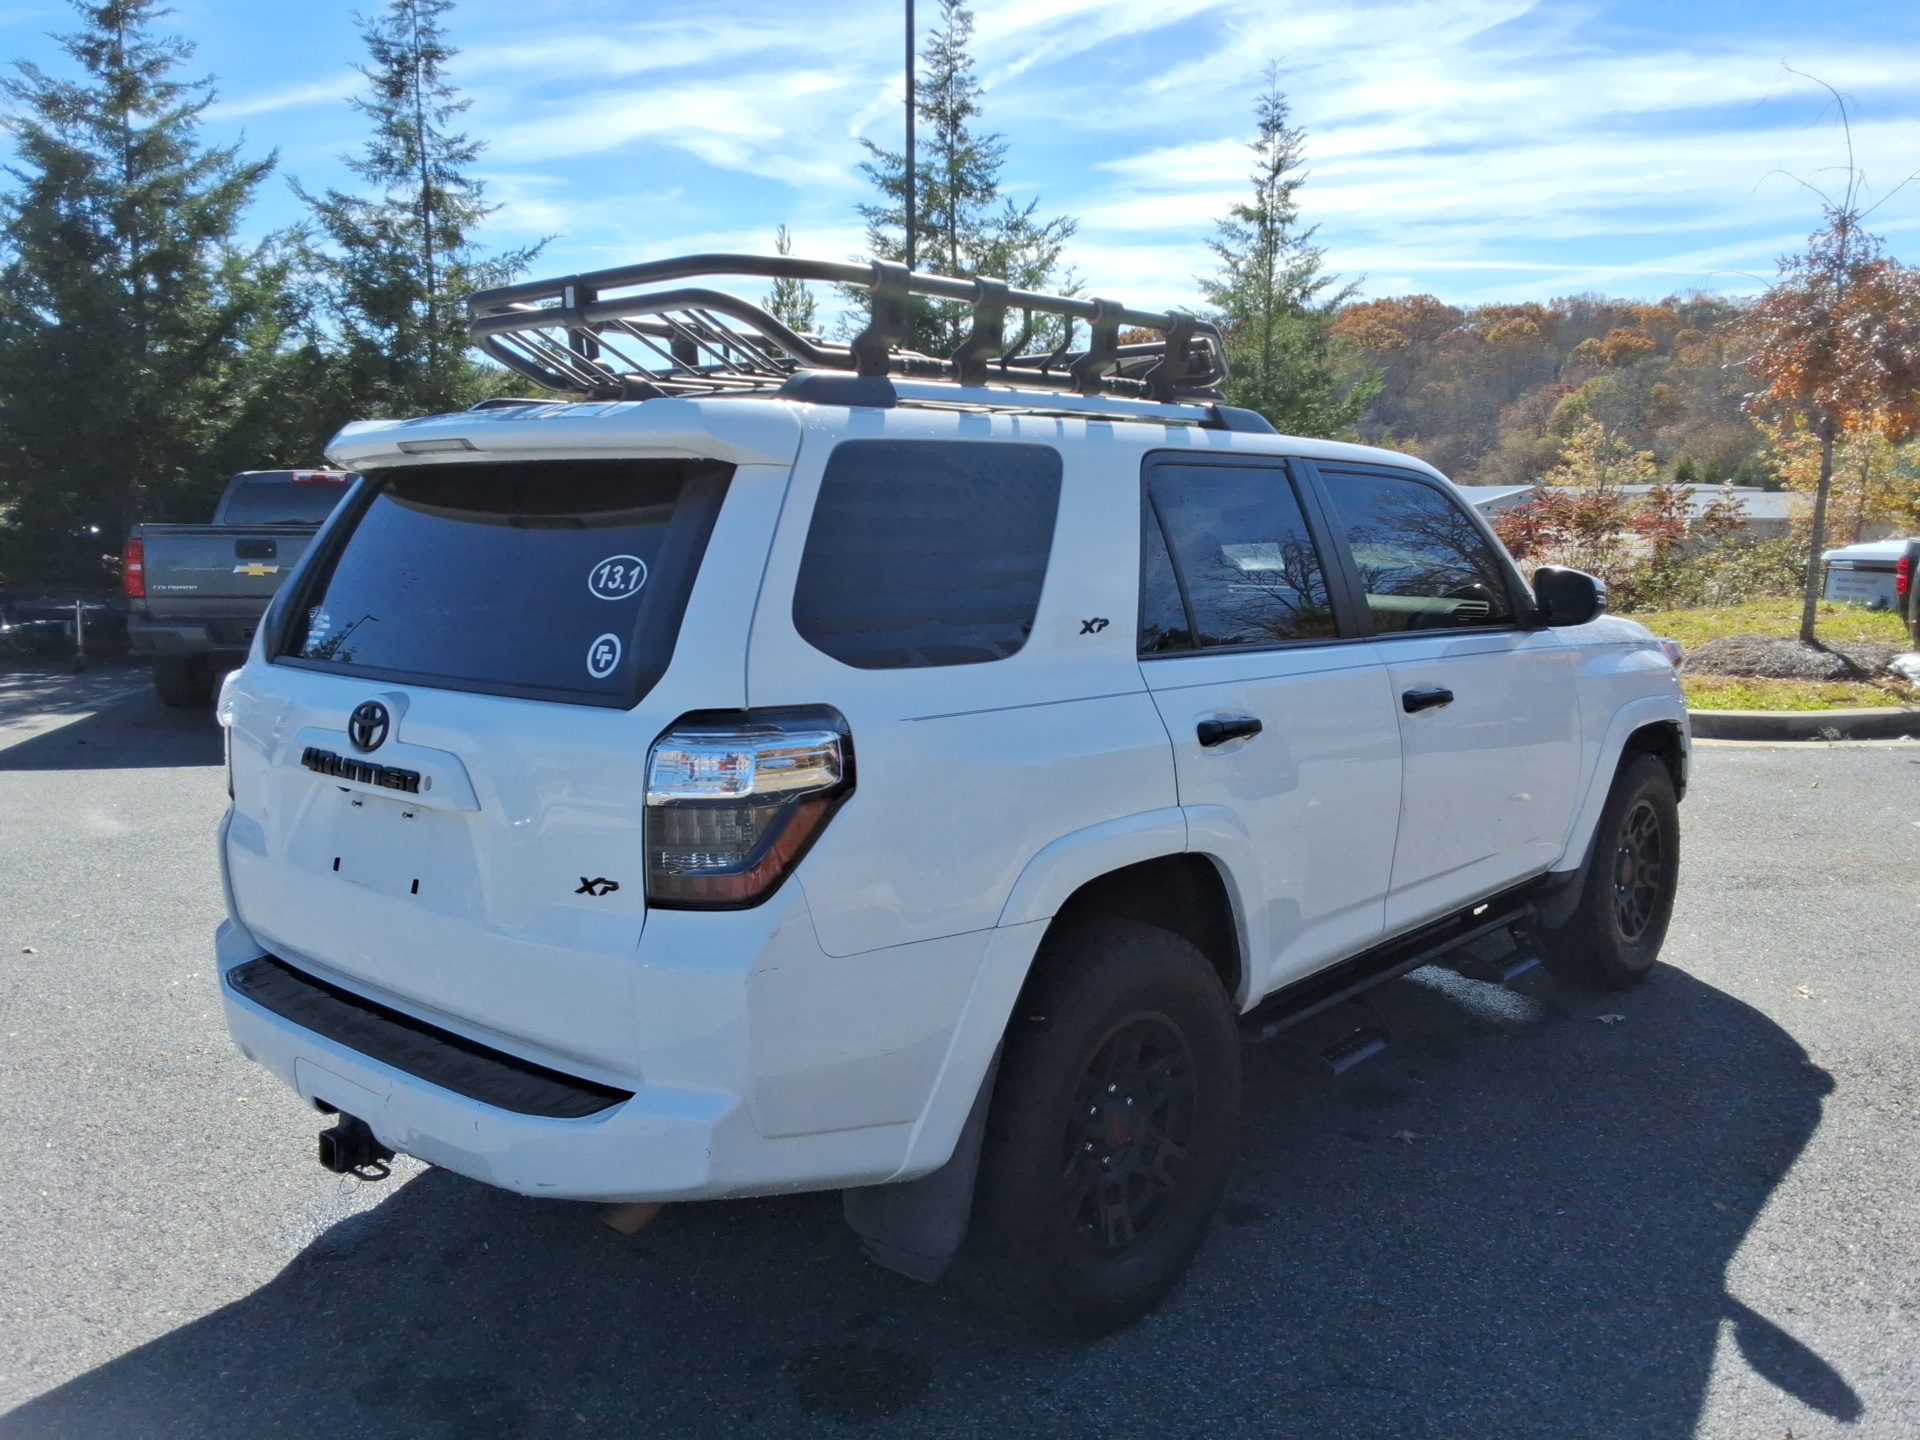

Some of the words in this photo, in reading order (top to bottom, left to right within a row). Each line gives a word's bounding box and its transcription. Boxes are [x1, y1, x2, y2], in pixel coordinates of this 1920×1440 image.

[598, 564, 641, 590] 13.1
[1079, 617, 1110, 635] XP
[301, 746, 421, 794] 4RUNNER
[574, 876, 620, 897] XP
